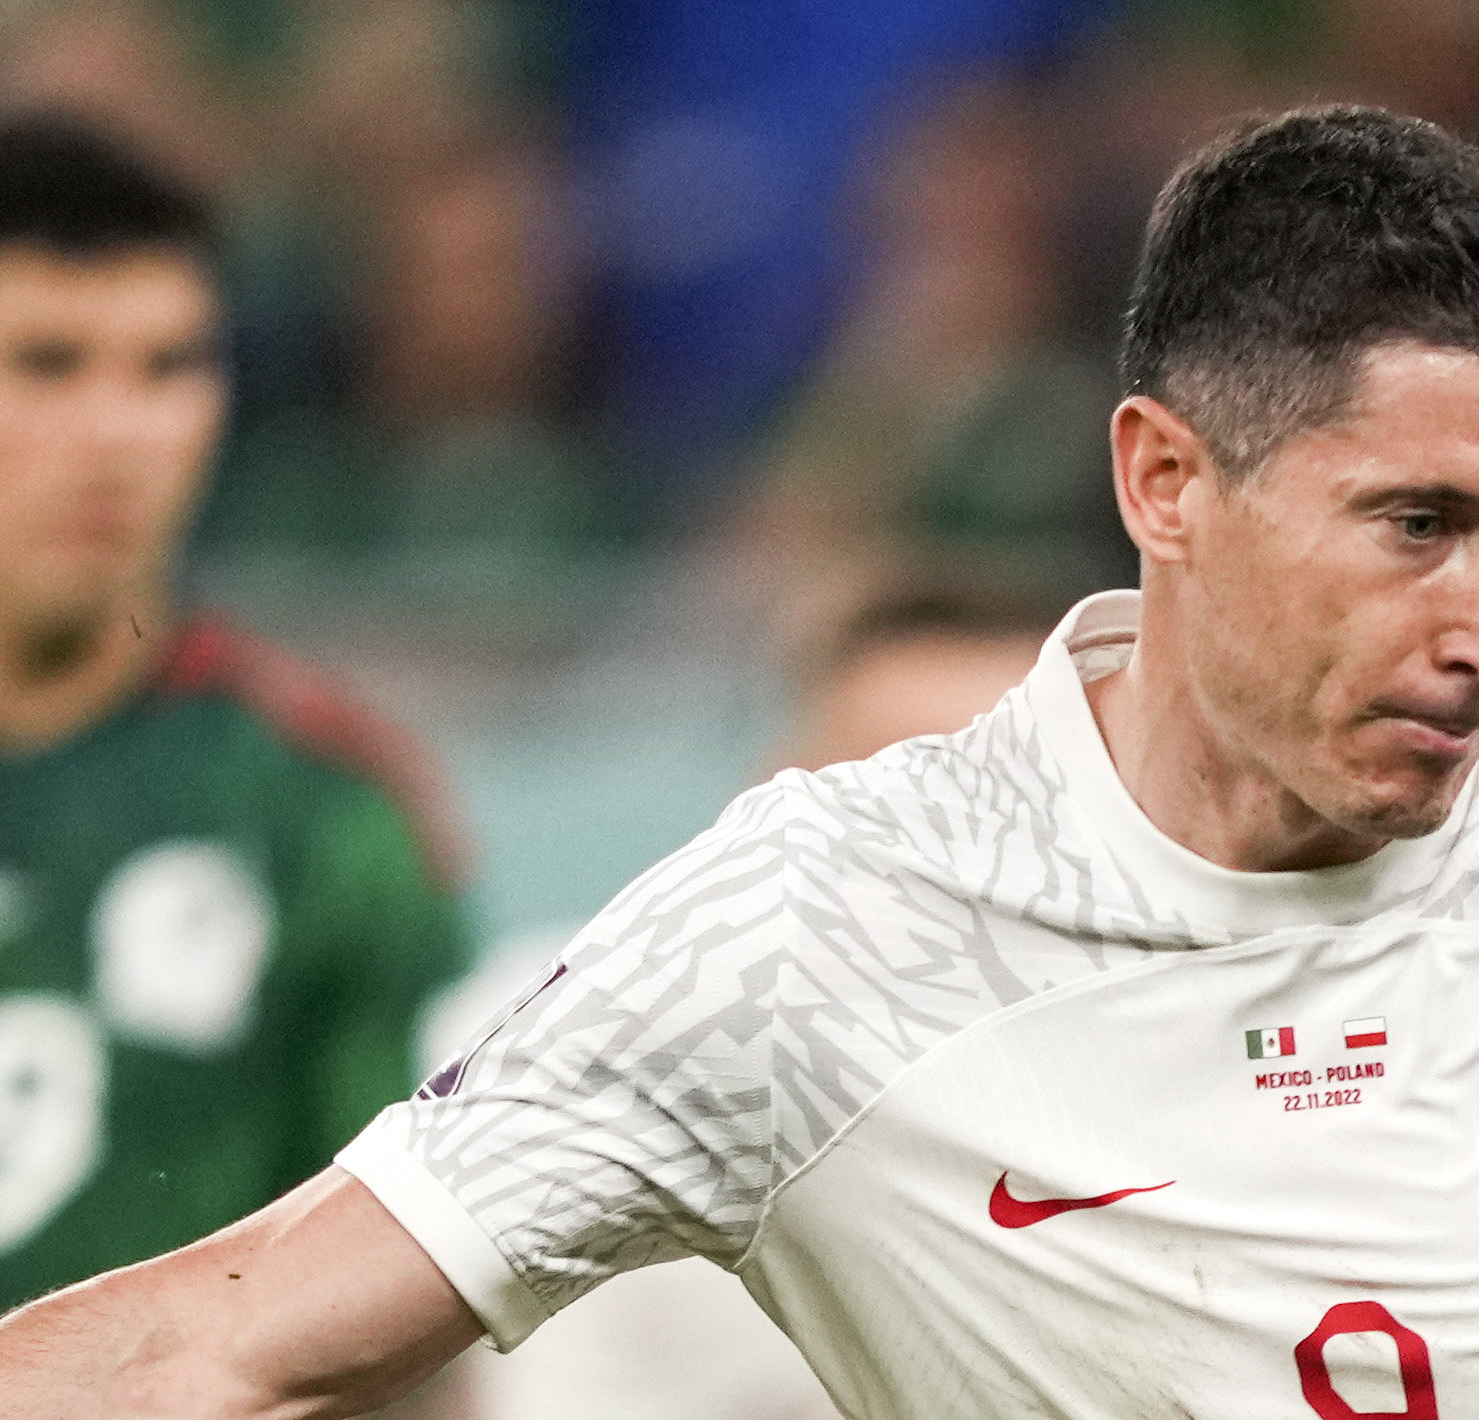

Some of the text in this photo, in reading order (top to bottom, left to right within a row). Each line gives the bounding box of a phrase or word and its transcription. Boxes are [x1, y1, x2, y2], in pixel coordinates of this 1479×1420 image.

[1255, 1069, 1312, 1090] MEXICO
[1326, 1062, 1385, 1083] POLAND
[1283, 1088, 1362, 1112] 22.11.2022
